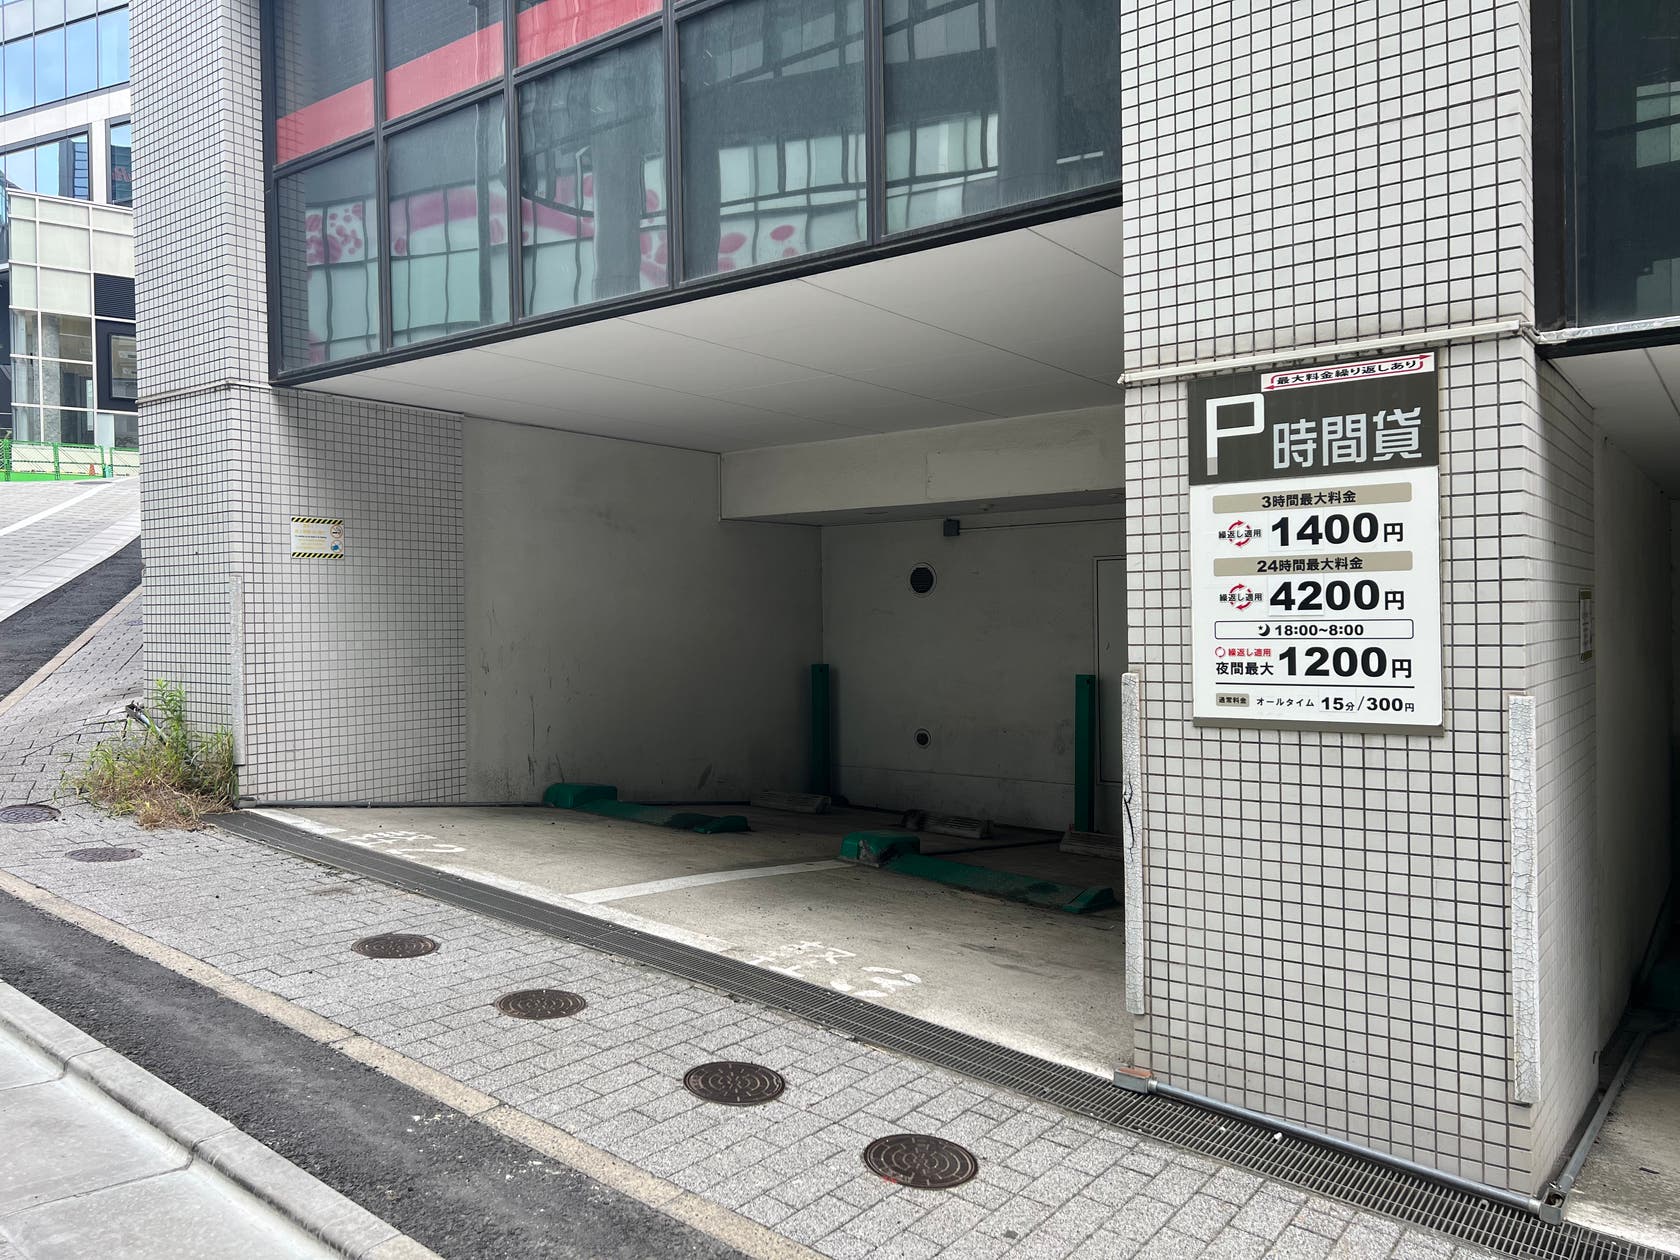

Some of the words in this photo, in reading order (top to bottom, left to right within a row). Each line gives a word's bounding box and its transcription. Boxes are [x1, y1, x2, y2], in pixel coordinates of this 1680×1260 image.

[1277, 360, 1416, 385] 最大料金繰り返しあり
[1205, 392, 1265, 477] P
[1273, 406, 1422, 470] 時間貸
[1261, 490, 1357, 509] 3時間最大料金
[1271, 512, 1404, 547] 1400円
[1256, 556, 1364, 573] 24時間最大料金
[1269, 579, 1405, 611] 4200円
[1215, 661, 1274, 676] 夜間最大
[1279, 646, 1412, 679] 1200円
[1256, 697, 1315, 708] オールタイム
